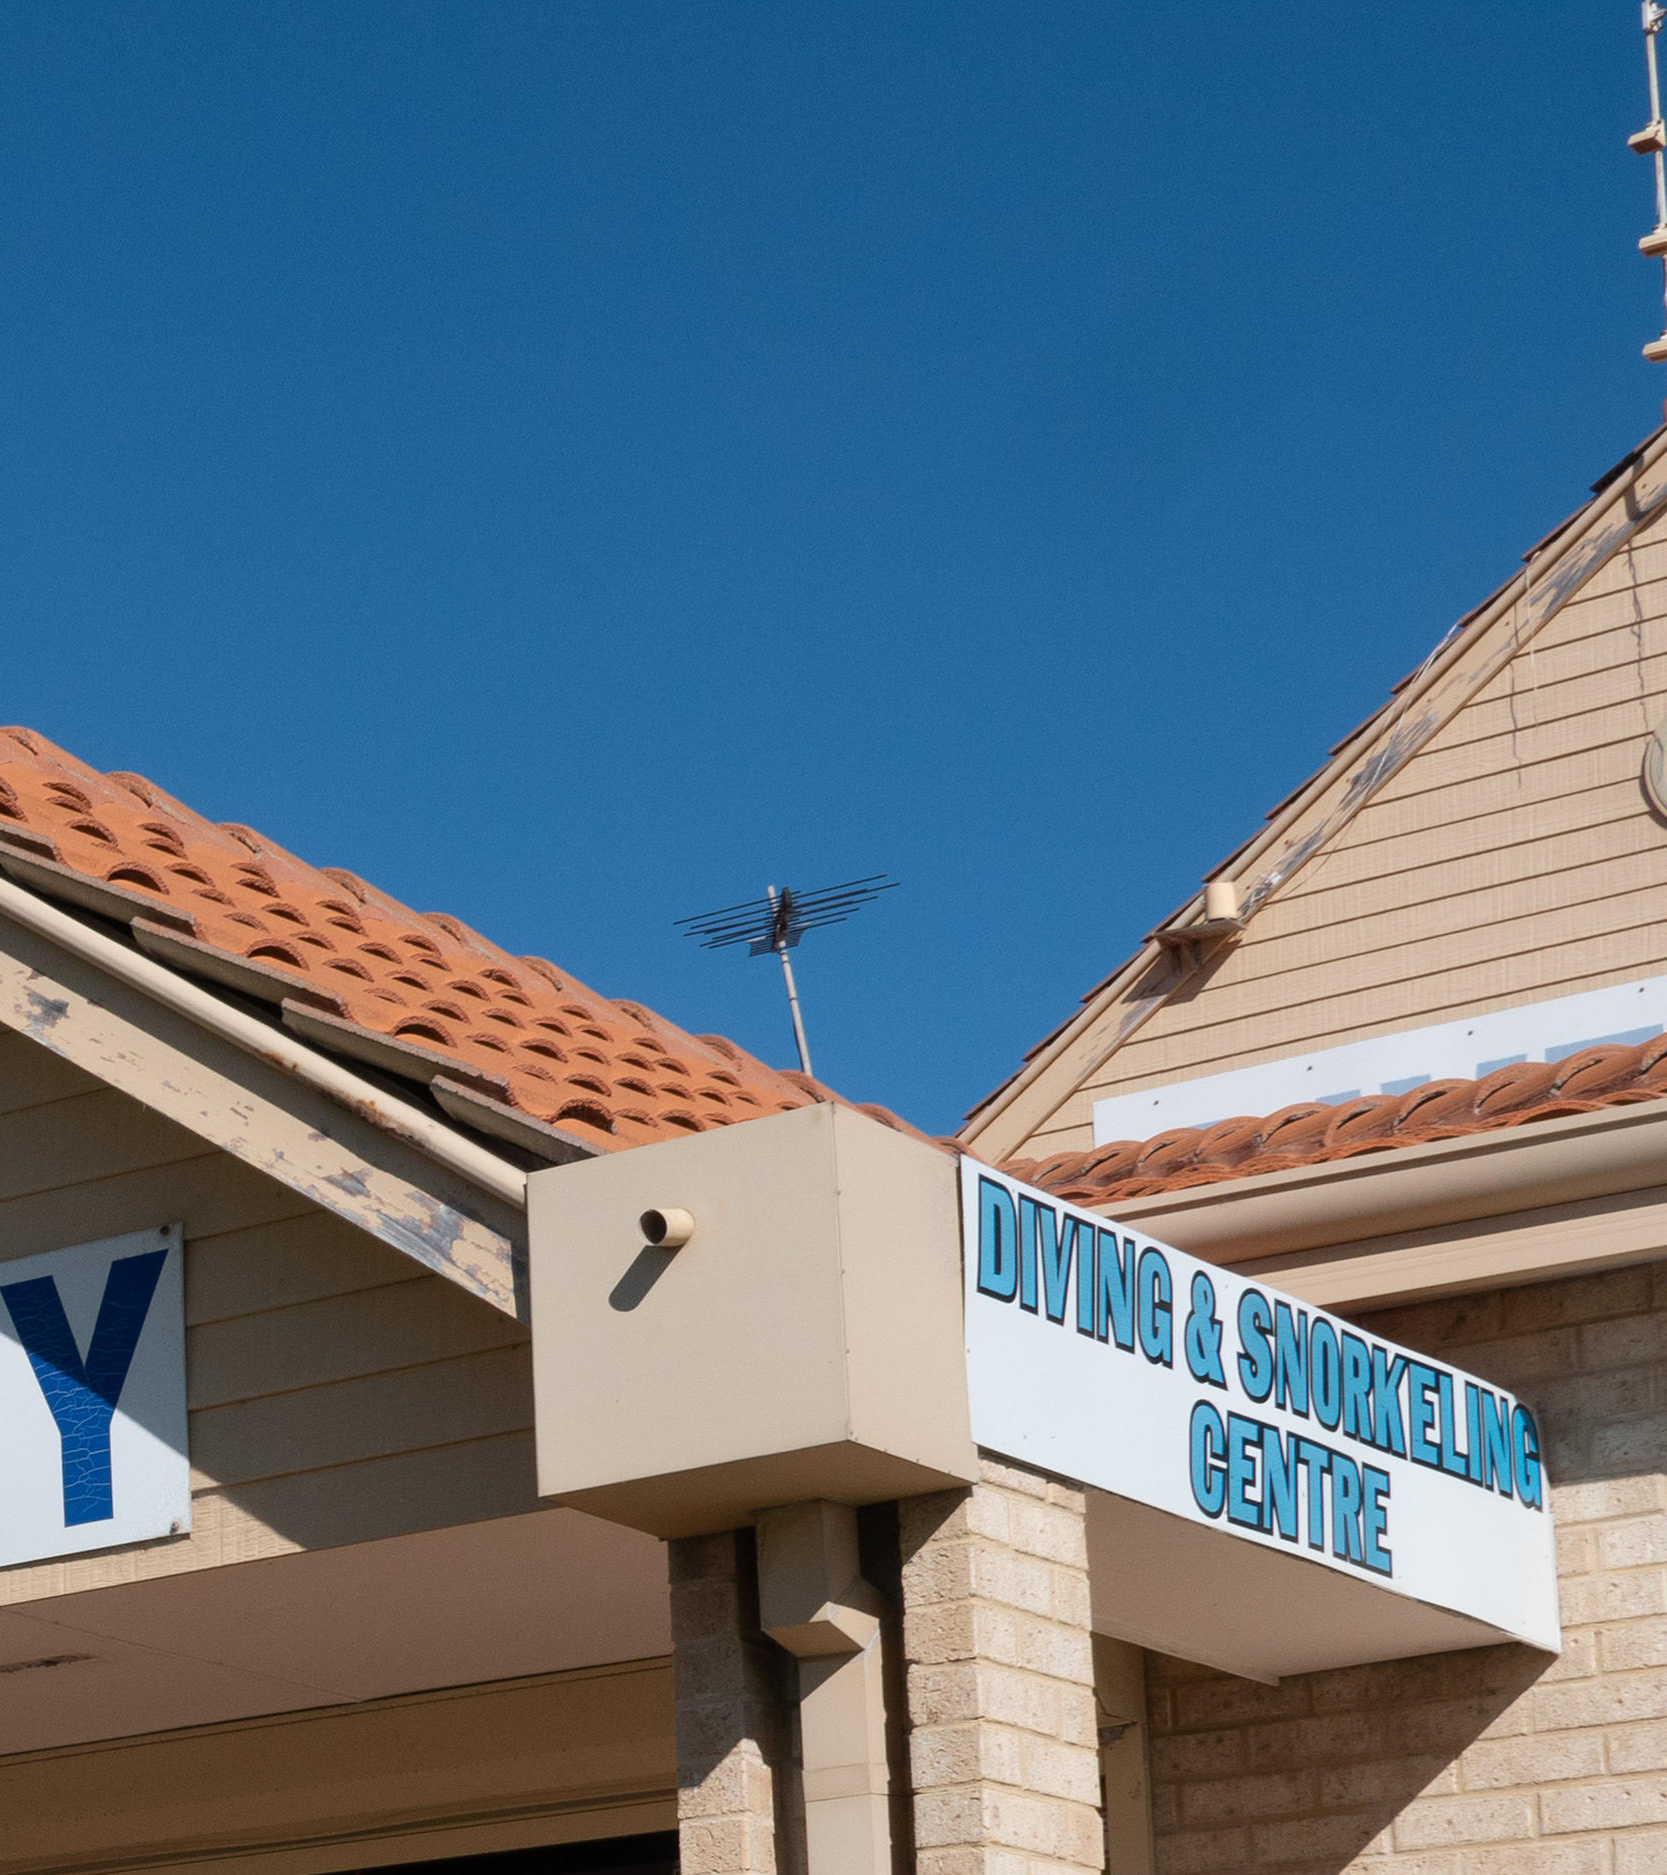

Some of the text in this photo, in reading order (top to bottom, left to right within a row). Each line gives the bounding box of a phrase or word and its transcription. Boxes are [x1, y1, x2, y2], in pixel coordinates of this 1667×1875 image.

[977, 1174, 1544, 1512] DIVING & SNORKELING
[1188, 1398, 1394, 1578] CENTRE
